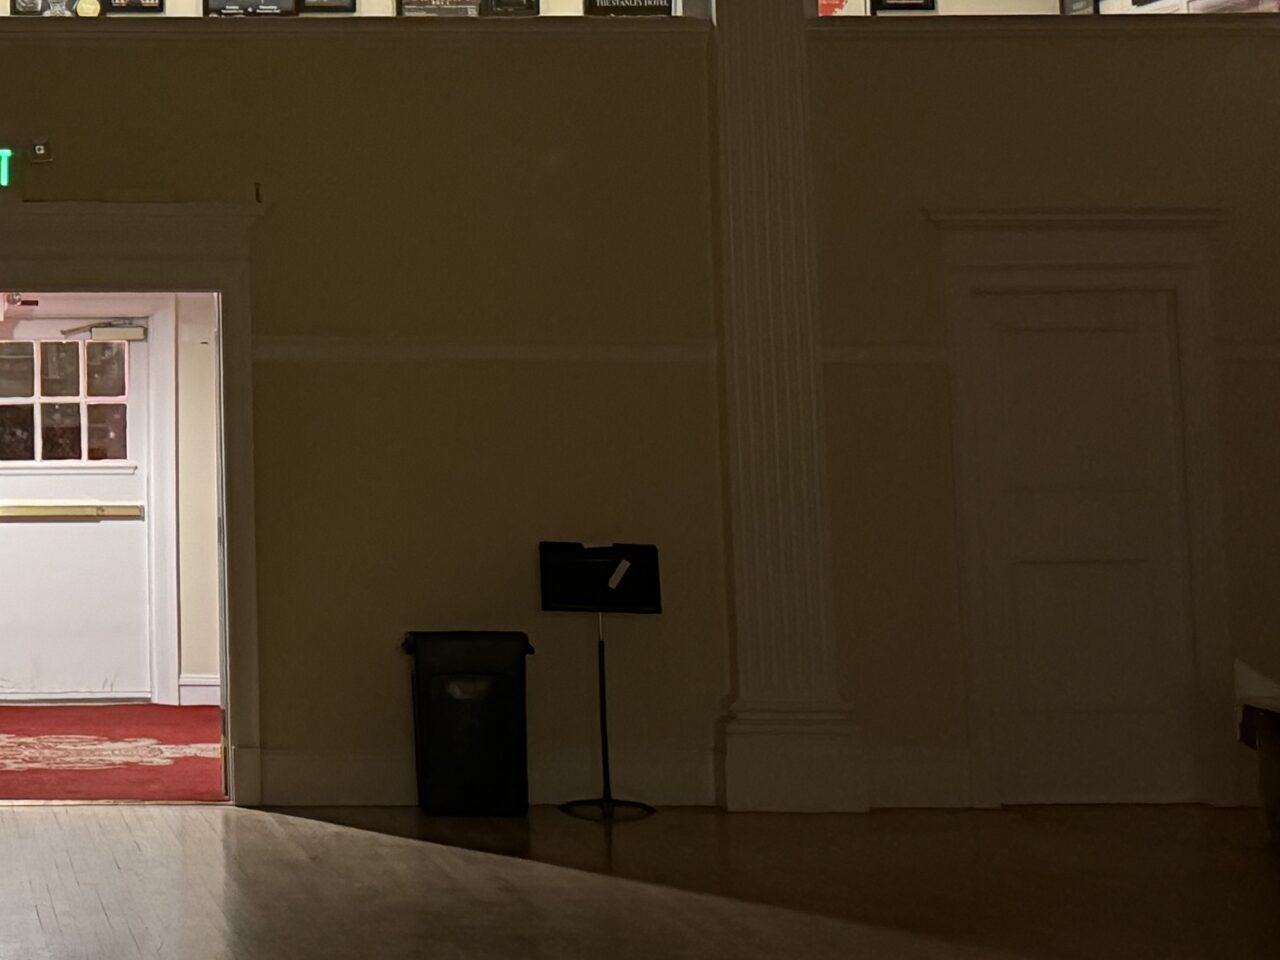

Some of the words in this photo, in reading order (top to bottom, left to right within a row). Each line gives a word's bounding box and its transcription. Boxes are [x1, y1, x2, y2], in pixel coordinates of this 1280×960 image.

[596, 0, 611, 7] THE
[611, 0, 642, 7] STANLEY
[644, 0, 670, 7] HOTEL
